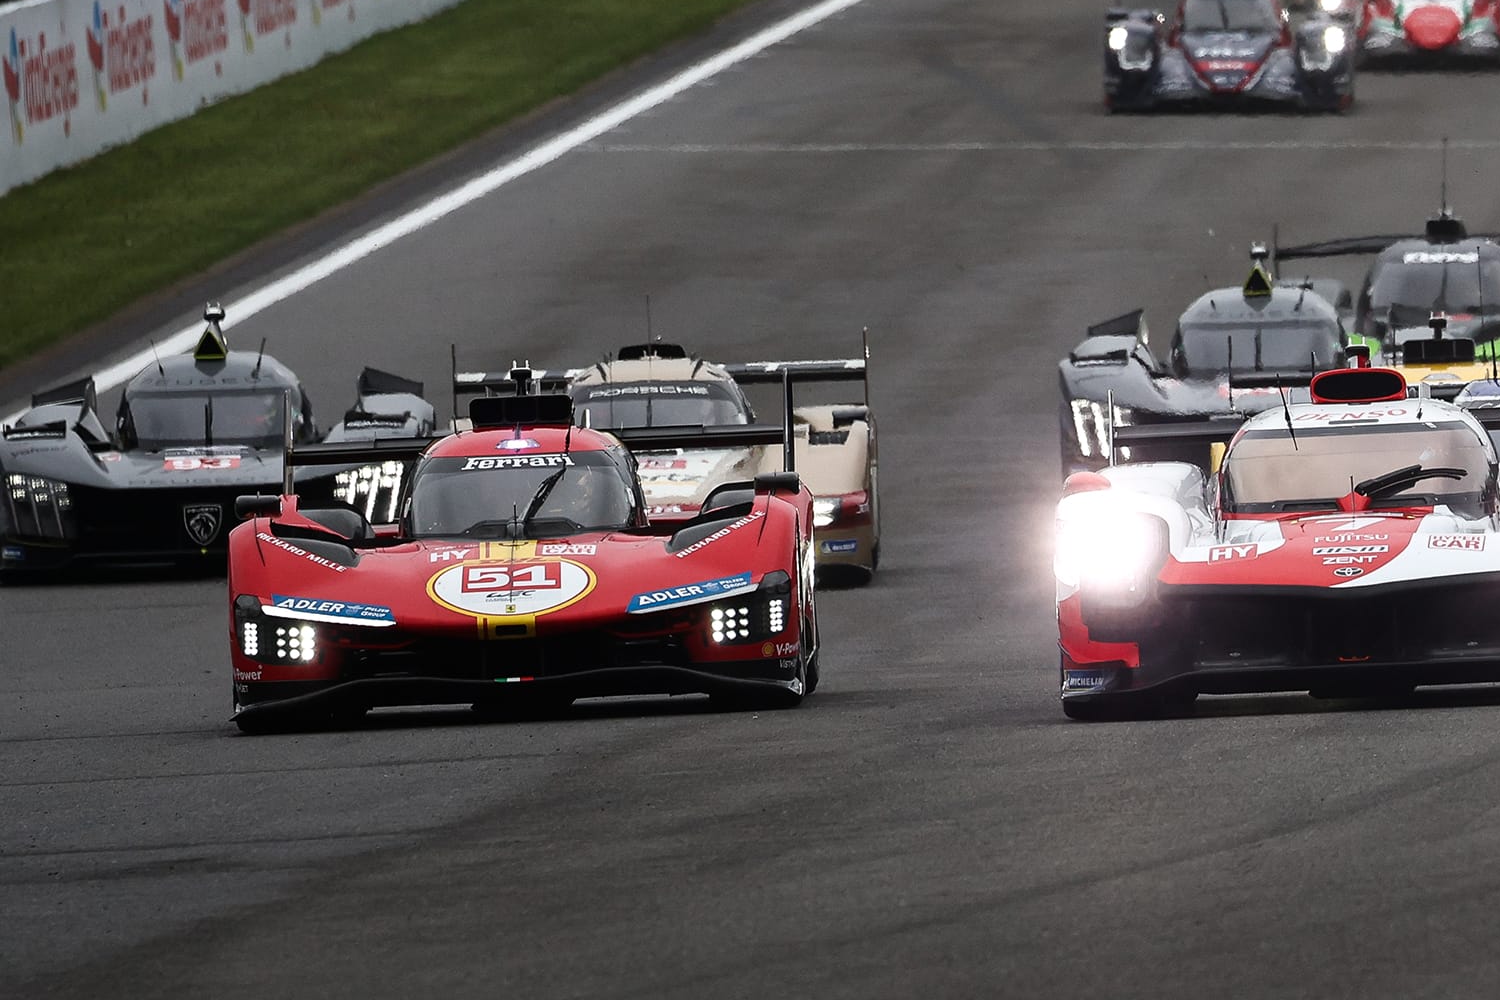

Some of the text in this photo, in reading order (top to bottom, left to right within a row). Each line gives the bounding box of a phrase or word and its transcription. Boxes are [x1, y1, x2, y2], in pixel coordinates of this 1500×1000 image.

[589, 385, 709, 399] PORSCHE
[1295, 408, 1407, 422] DENSO
[461, 453, 575, 471] Ferrari
[676, 510, 766, 558] RICHARD MILLE
[1314, 532, 1389, 543] FUJITSU
[1432, 540, 1481, 549] CAR
[256, 532, 347, 573] RICHARD MILLE
[430, 550, 470, 563] HY
[1211, 545, 1255, 561] HY
[1322, 555, 1378, 565] ZENT
[467, 565, 556, 589] 51
[639, 585, 703, 606] ADLER
[277, 599, 345, 613] ADLER
